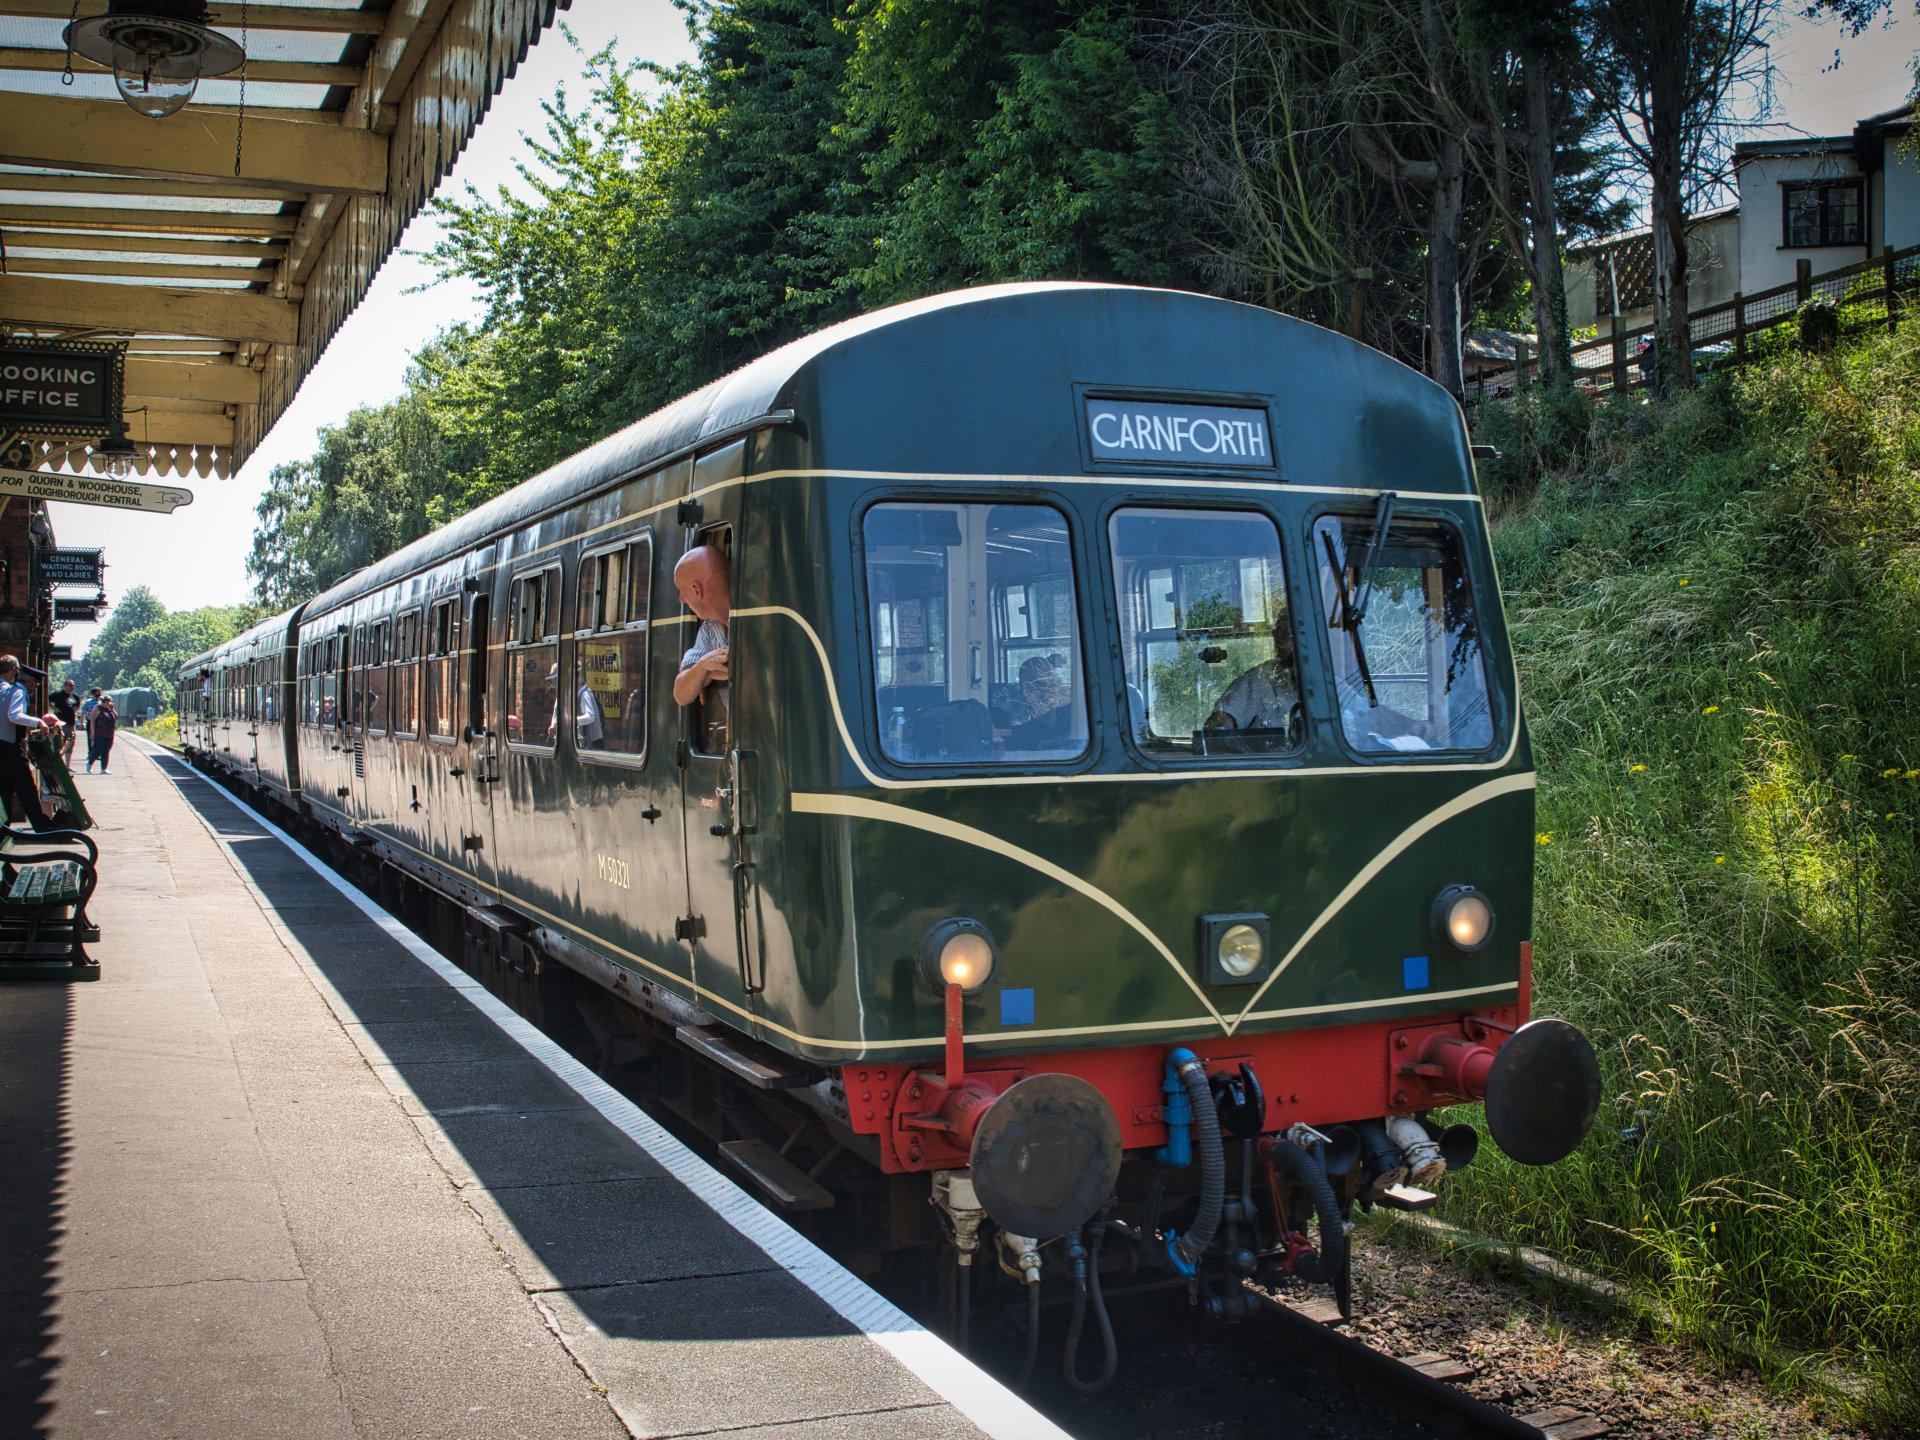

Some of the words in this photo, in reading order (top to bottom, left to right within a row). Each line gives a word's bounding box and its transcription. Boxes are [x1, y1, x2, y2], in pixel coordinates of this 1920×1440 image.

[0, 365, 96, 385] OOKING
[0, 388, 80, 407] FFICE
[1092, 413, 1265, 457] CARNFORTH
[0, 476, 23, 486] FOR
[28, 475, 64, 487] QUORN
[67, 480, 74, 488] &
[78, 481, 142, 496] WOODHOUSE,
[27, 485, 100, 501] LOUGHBOROUGH
[103, 494, 142, 506] CENTRAL
[64, 571, 92, 579] LADIES
[598, 853, 607, 881] M
[607, 856, 630, 890] 50321
